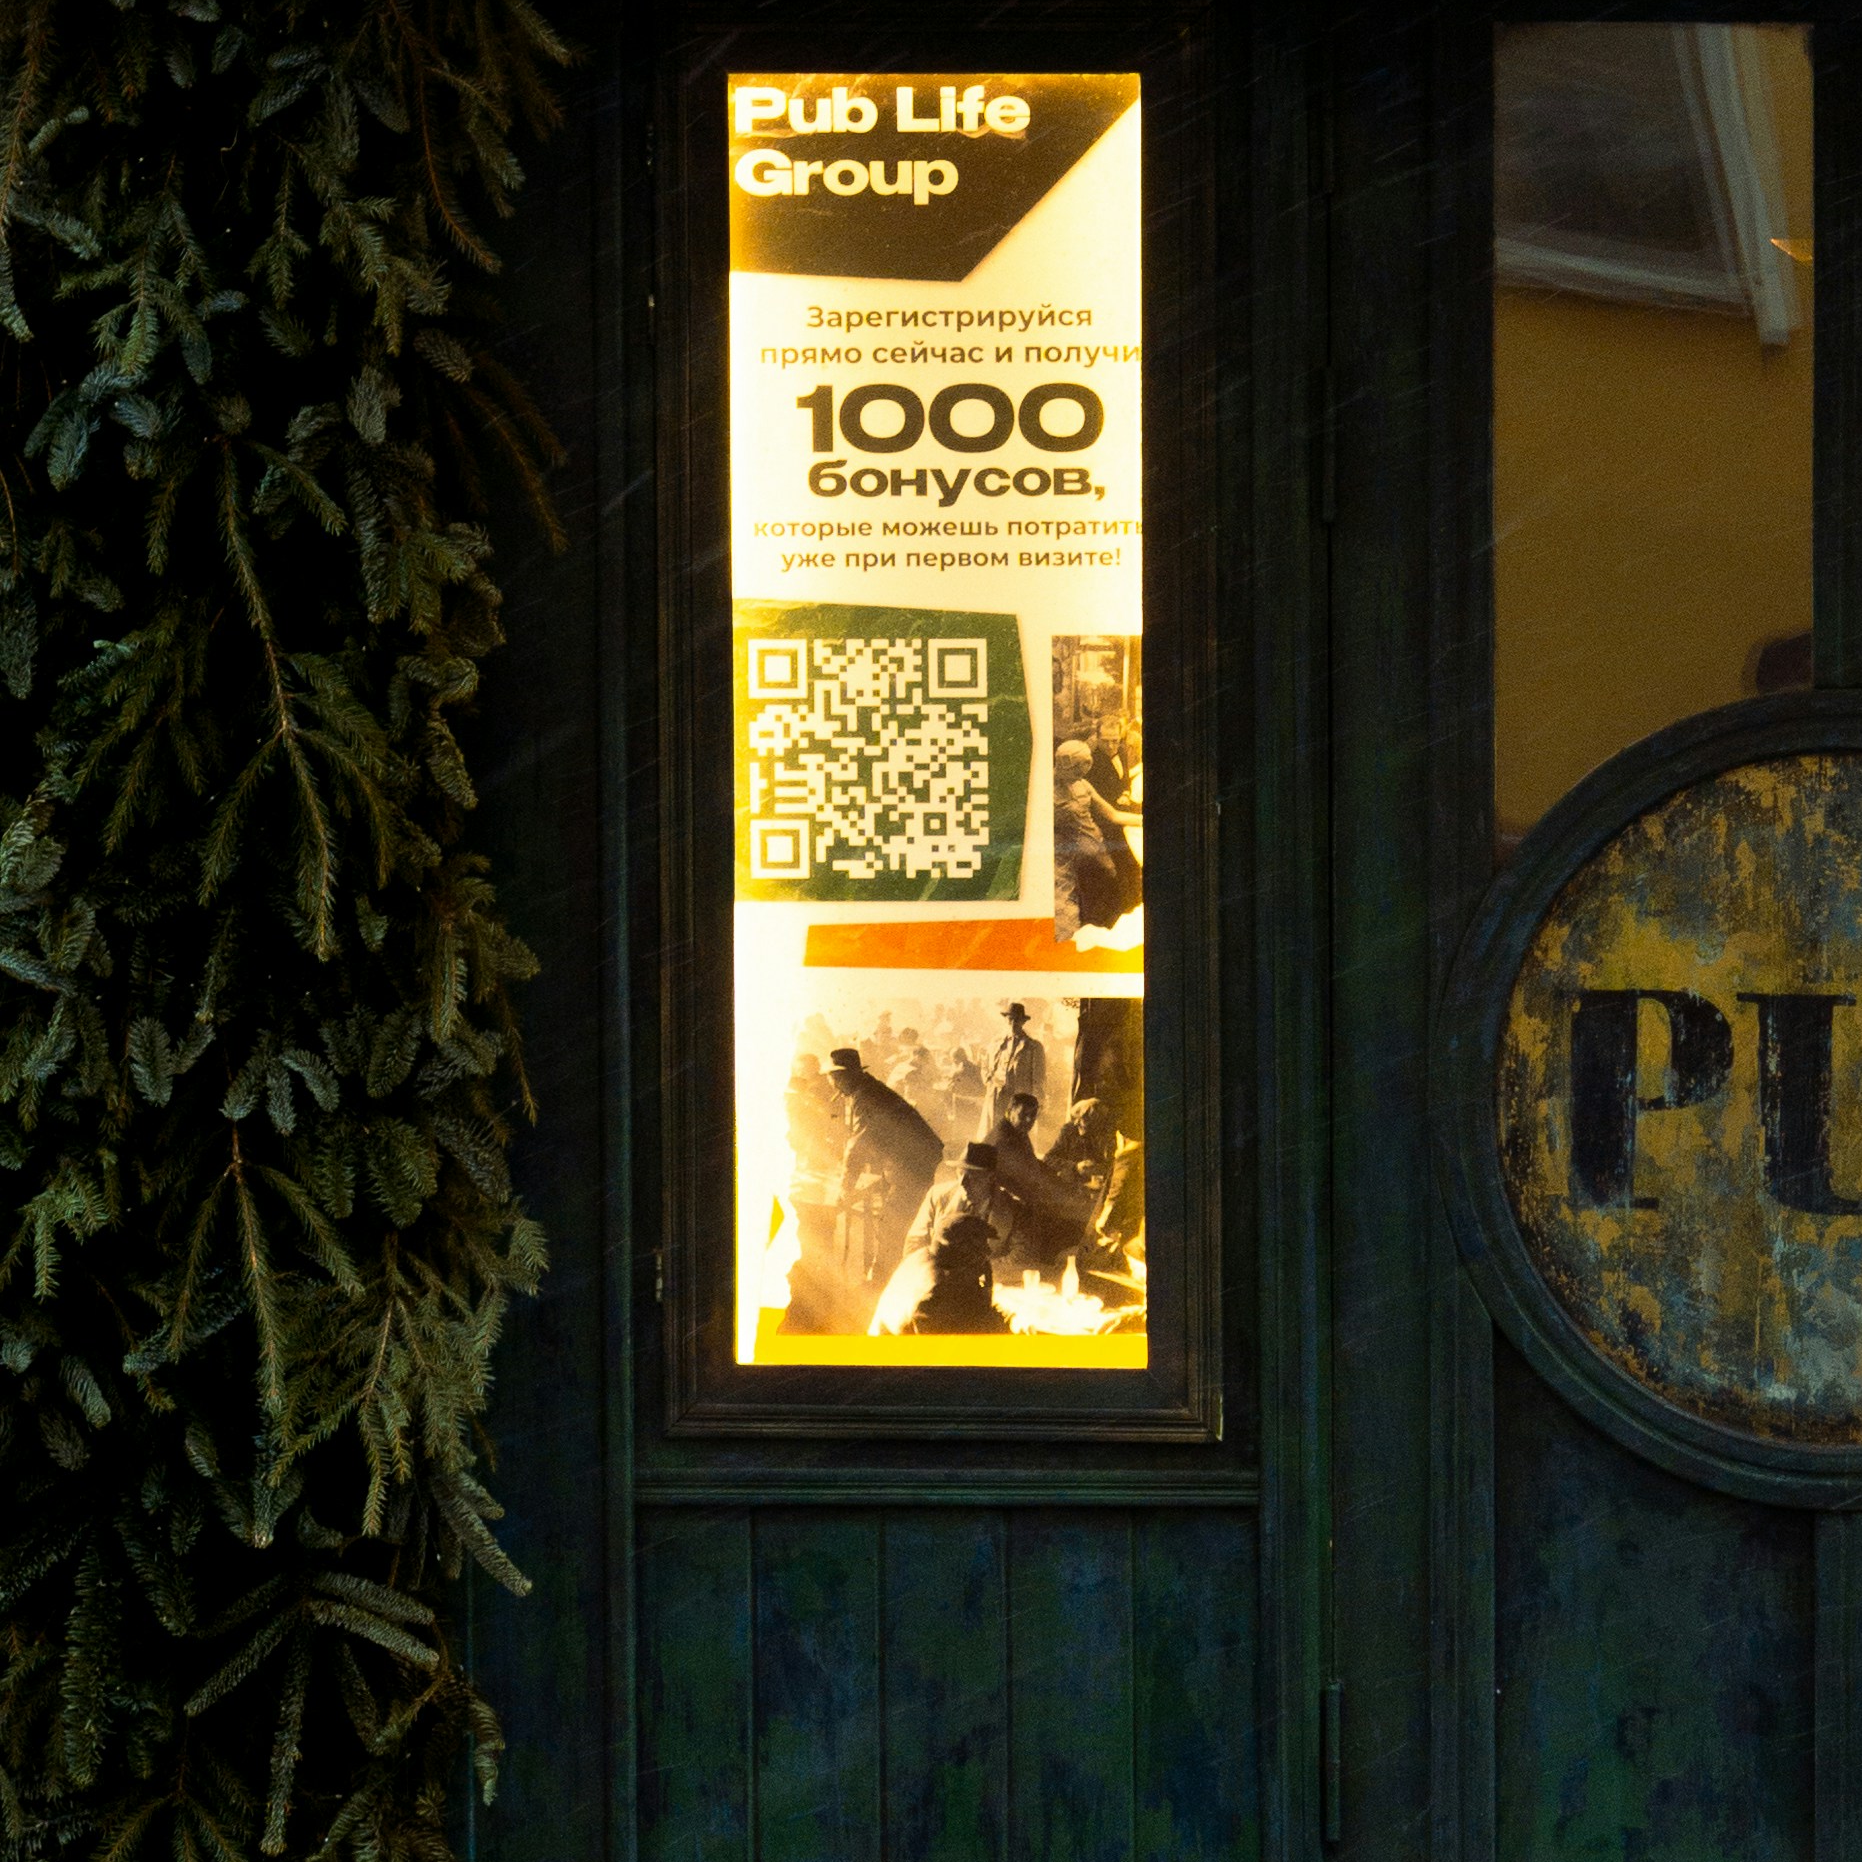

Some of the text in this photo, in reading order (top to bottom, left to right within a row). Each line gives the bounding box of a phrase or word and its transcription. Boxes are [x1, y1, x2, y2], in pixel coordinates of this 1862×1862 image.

[734, 85, 1031, 134] Pub Life
[734, 148, 959, 205] Group
[807, 304, 1092, 333] Зарегистрируйся
[760, 341, 1141, 370] прямо сейчас и получи
[796, 382, 1105, 454] 1000
[808, 459, 1106, 508] бонусов,
[754, 519, 873, 541] которые
[882, 519, 999, 536] можешь
[781, 547, 1122, 570] уже при первом визите!
